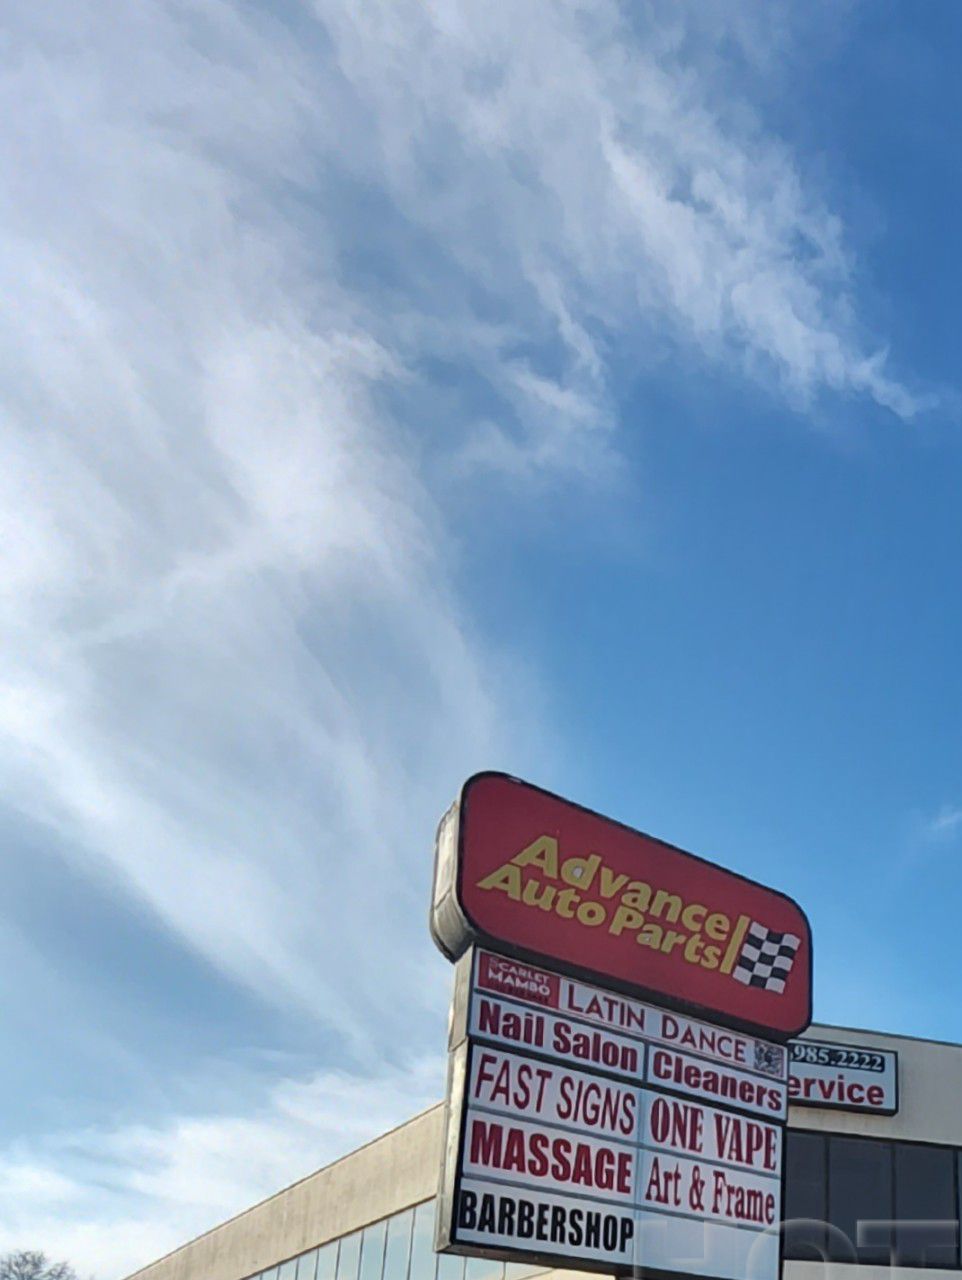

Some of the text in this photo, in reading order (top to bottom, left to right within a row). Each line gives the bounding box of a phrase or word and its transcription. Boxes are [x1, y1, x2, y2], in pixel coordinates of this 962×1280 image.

[476, 864, 721, 971] Auto Parts
[511, 835, 730, 941] Advance
[488, 968, 551, 996] MAMBO
[478, 998, 638, 1073] Nail Salon
[568, 983, 646, 1031] LATIN
[661, 1014, 747, 1062] DANCE
[474, 1054, 636, 1136] FAST SIGNS
[652, 1050, 783, 1112] Cleaners
[788, 1074, 885, 1105] ervice
[469, 1119, 633, 1194] MASSAGE
[651, 1097, 778, 1171] ONE VAPE
[458, 1190, 635, 1253] BARBERSHOP
[645, 1157, 775, 1225] Art & Frame
